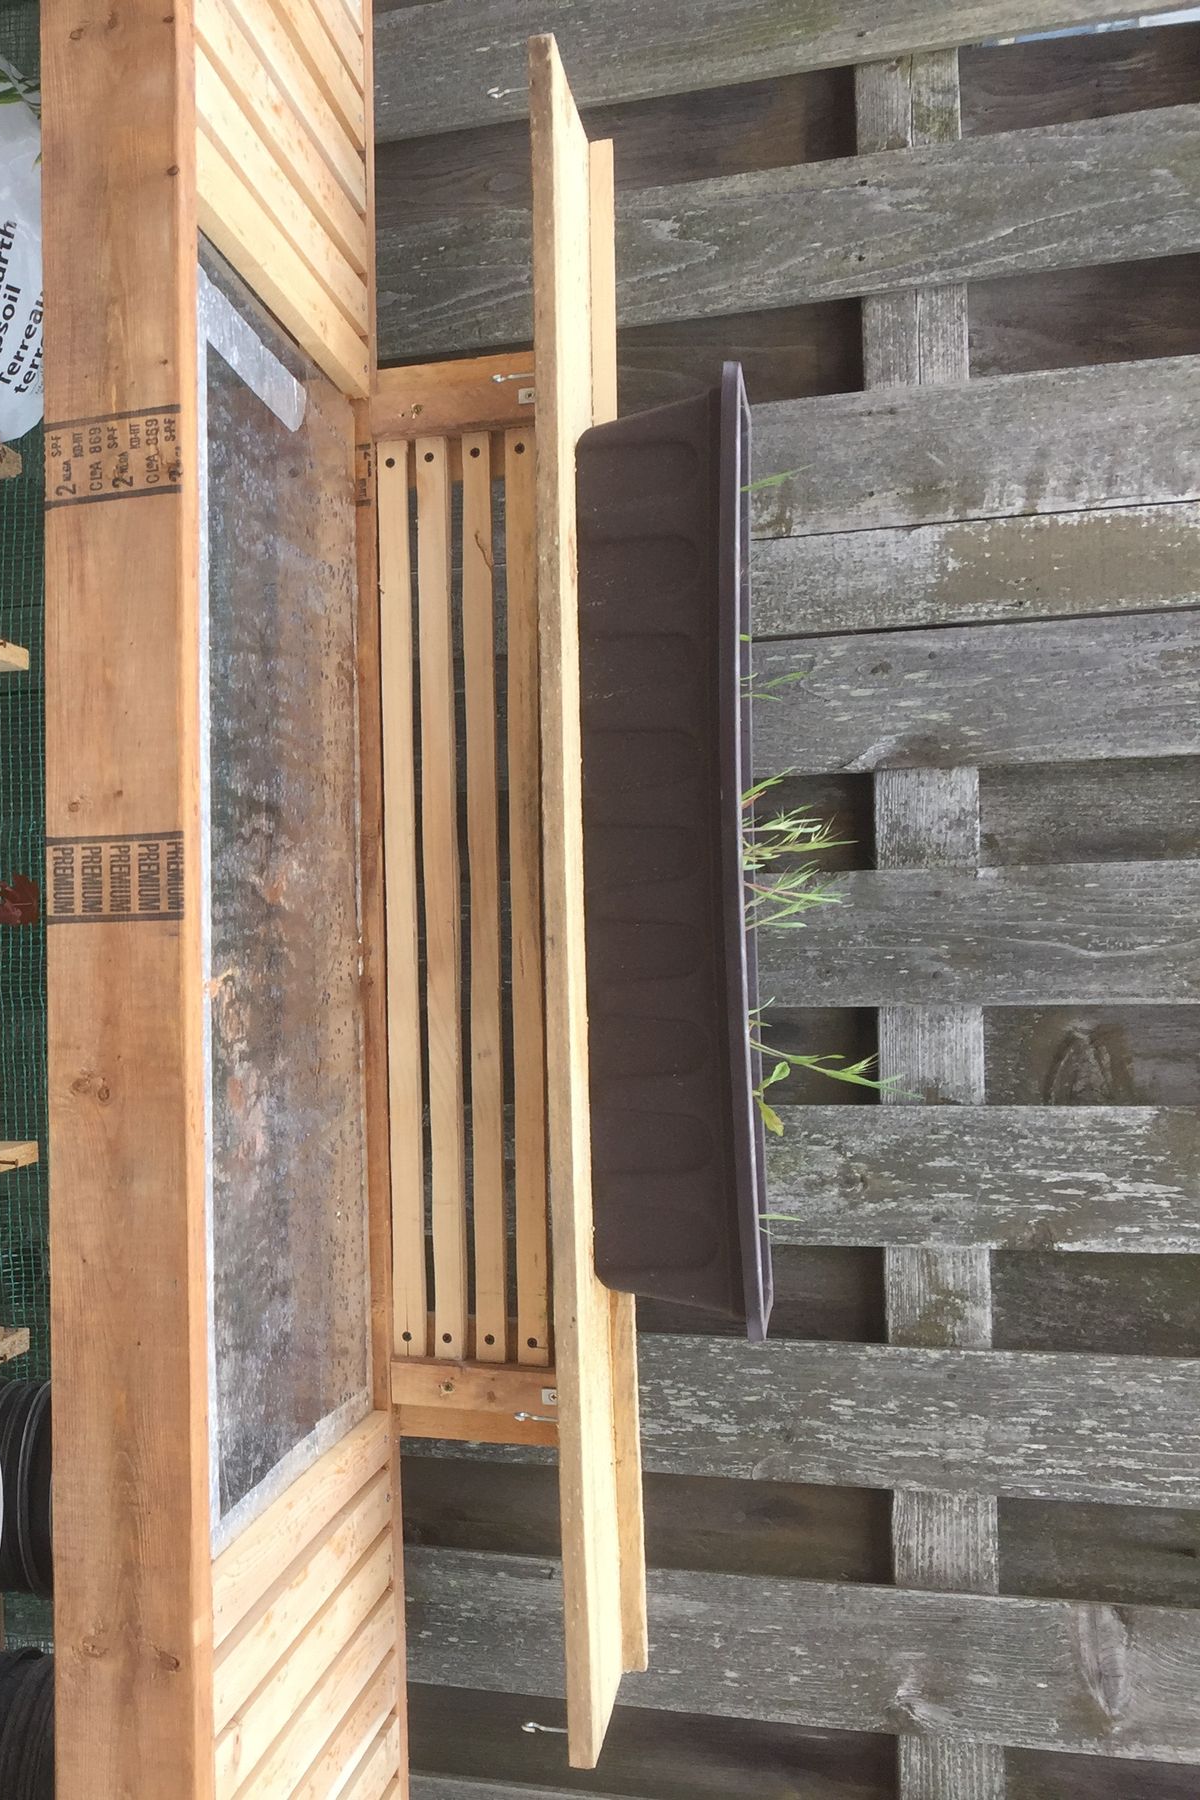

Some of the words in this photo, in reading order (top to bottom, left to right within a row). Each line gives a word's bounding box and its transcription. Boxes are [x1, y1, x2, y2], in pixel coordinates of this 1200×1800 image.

[14, 336, 44, 393] terr
[89, 427, 103, 454] 869
[145, 418, 159, 446] 869
[56, 483, 77, 497] 2
[112, 475, 134, 489] 2
[53, 847, 75, 913] PREMIUM
[81, 846, 103, 912] PREMIUM
[110, 845, 131, 912] PREMIUM
[138, 844, 160, 911] PREMIUM
